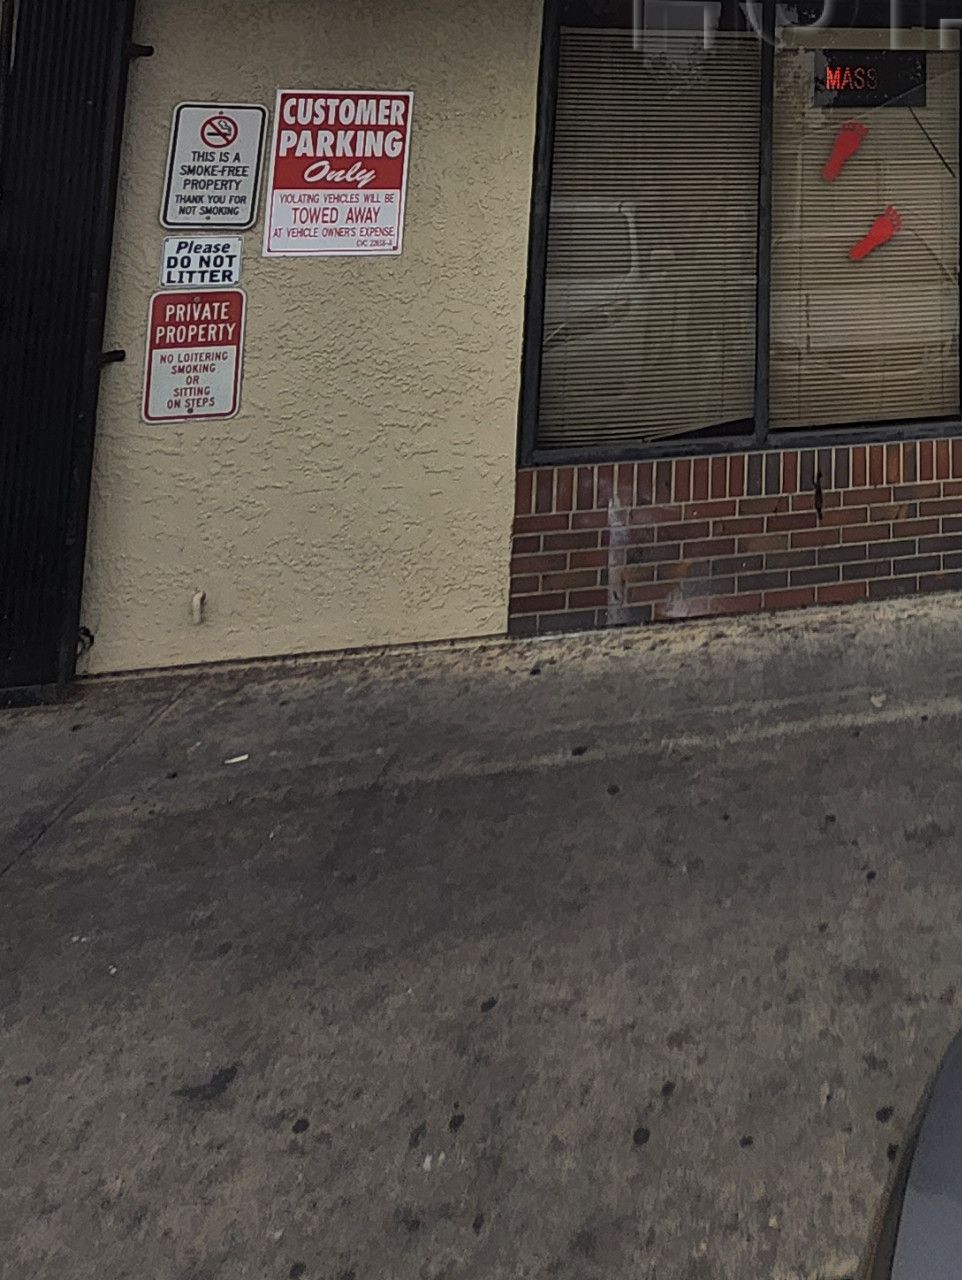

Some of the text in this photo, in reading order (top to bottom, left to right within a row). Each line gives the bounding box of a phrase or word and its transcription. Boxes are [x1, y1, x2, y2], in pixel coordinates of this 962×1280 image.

[283, 97, 406, 126] CUSTOMER
[279, 129, 403, 157] PARKING
[192, 151, 241, 163] THIS IS A
[179, 165, 249, 176] SMOKE-FREE
[303, 160, 377, 188] Only
[183, 179, 242, 190] PROPERTY
[175, 194, 247, 204] THANK YOU FOR
[280, 193, 394, 203] VIOLATING VEHICLES WILL BE
[179, 205, 239, 215] NOT SMOKING
[292, 207, 381, 224] TOWED AWAY
[273, 227, 283, 237] AT
[287, 227, 319, 238] VEHICLE
[360, 226, 395, 237] EXPENSE
[176, 241, 231, 254] Please
[166, 255, 237, 269] DO NOT
[166, 270, 233, 283] LITTER
[165, 302, 230, 322] PRIVATE
[156, 322, 236, 344] PROPERTY
[160, 351, 228, 364] NO LOITERING
[171, 363, 216, 374] SMOKING
[186, 375, 199, 385] OR
[173, 386, 210, 397] SITTING
[167, 397, 215, 409] ON STEPS
